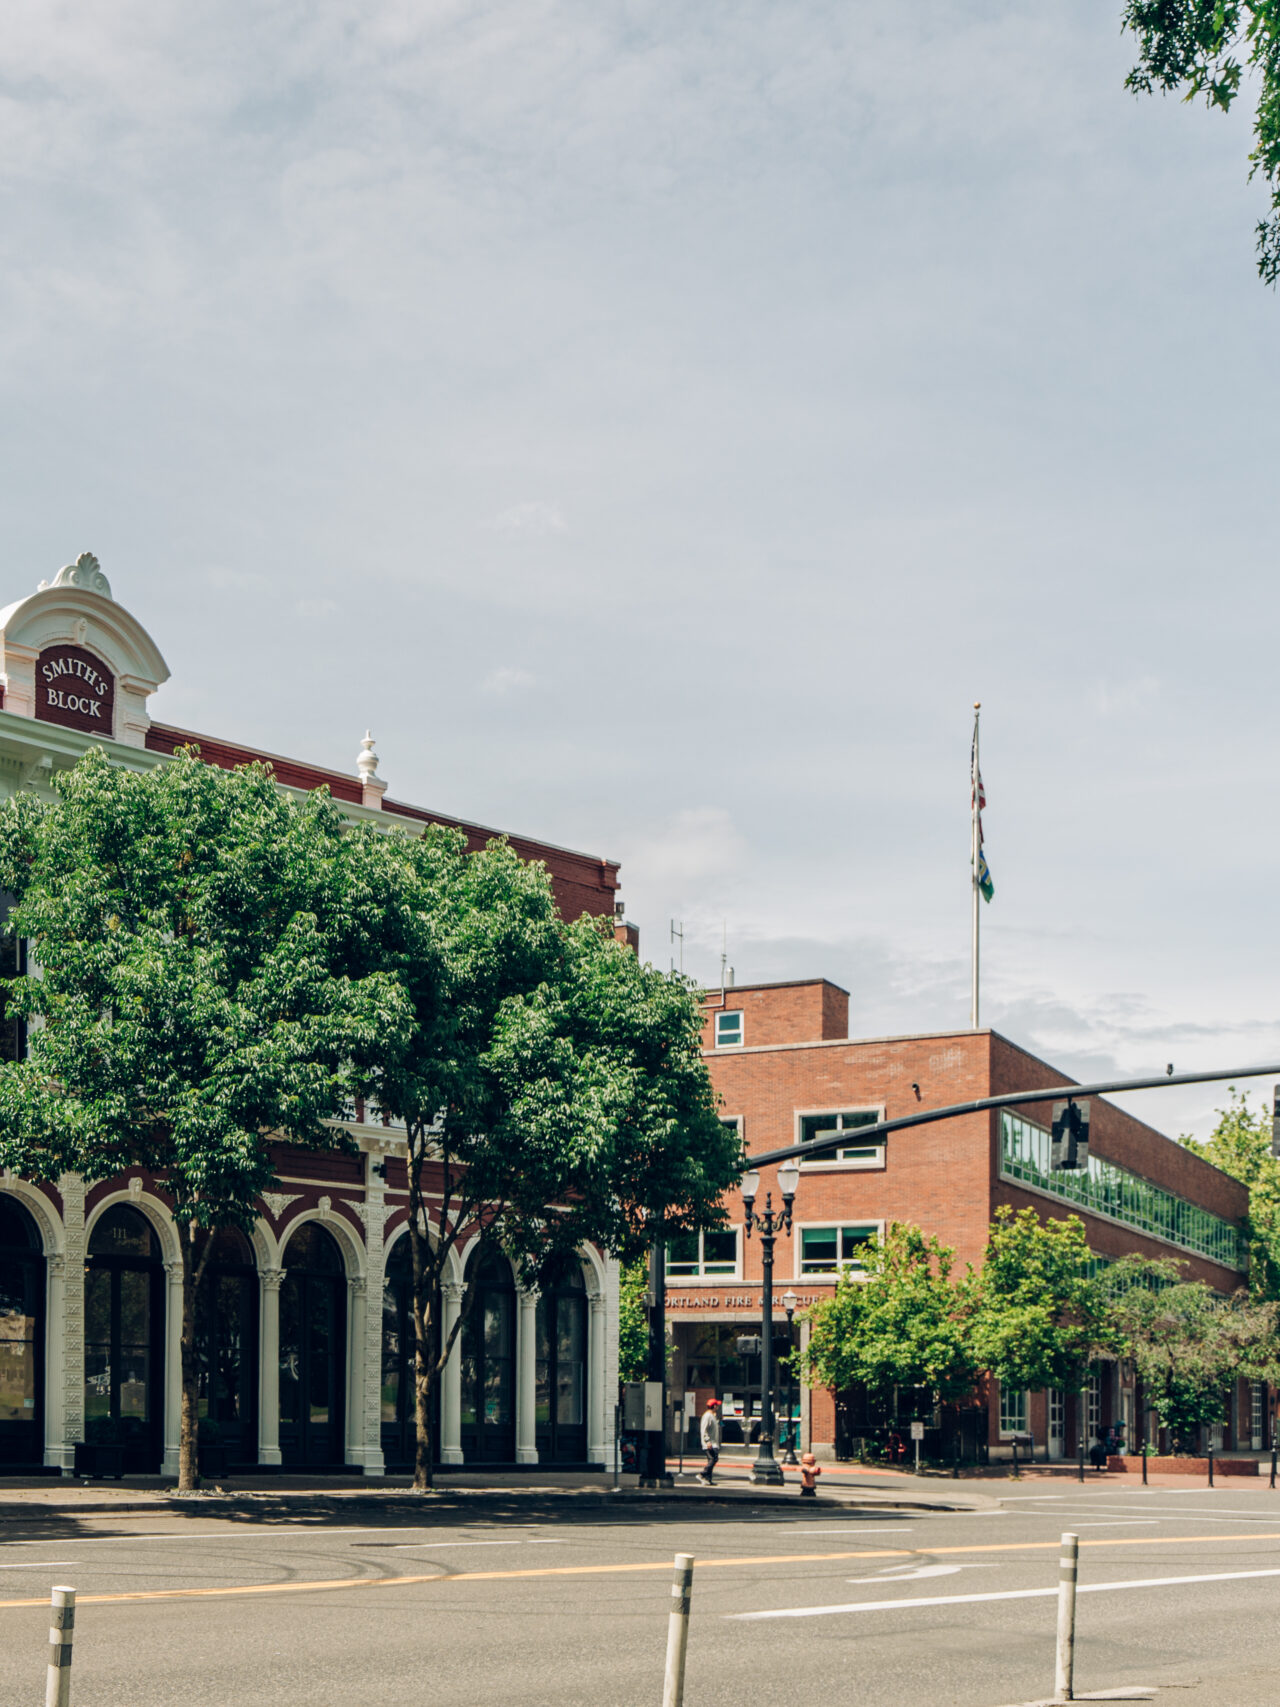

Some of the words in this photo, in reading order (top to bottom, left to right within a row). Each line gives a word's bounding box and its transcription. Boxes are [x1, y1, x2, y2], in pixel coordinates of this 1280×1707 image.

[42, 658, 108, 696] SMITH'S
[47, 688, 101, 717] BLOCK
[664, 1296, 719, 1307] ORTLAND
[725, 1295, 751, 1306] FIRE
